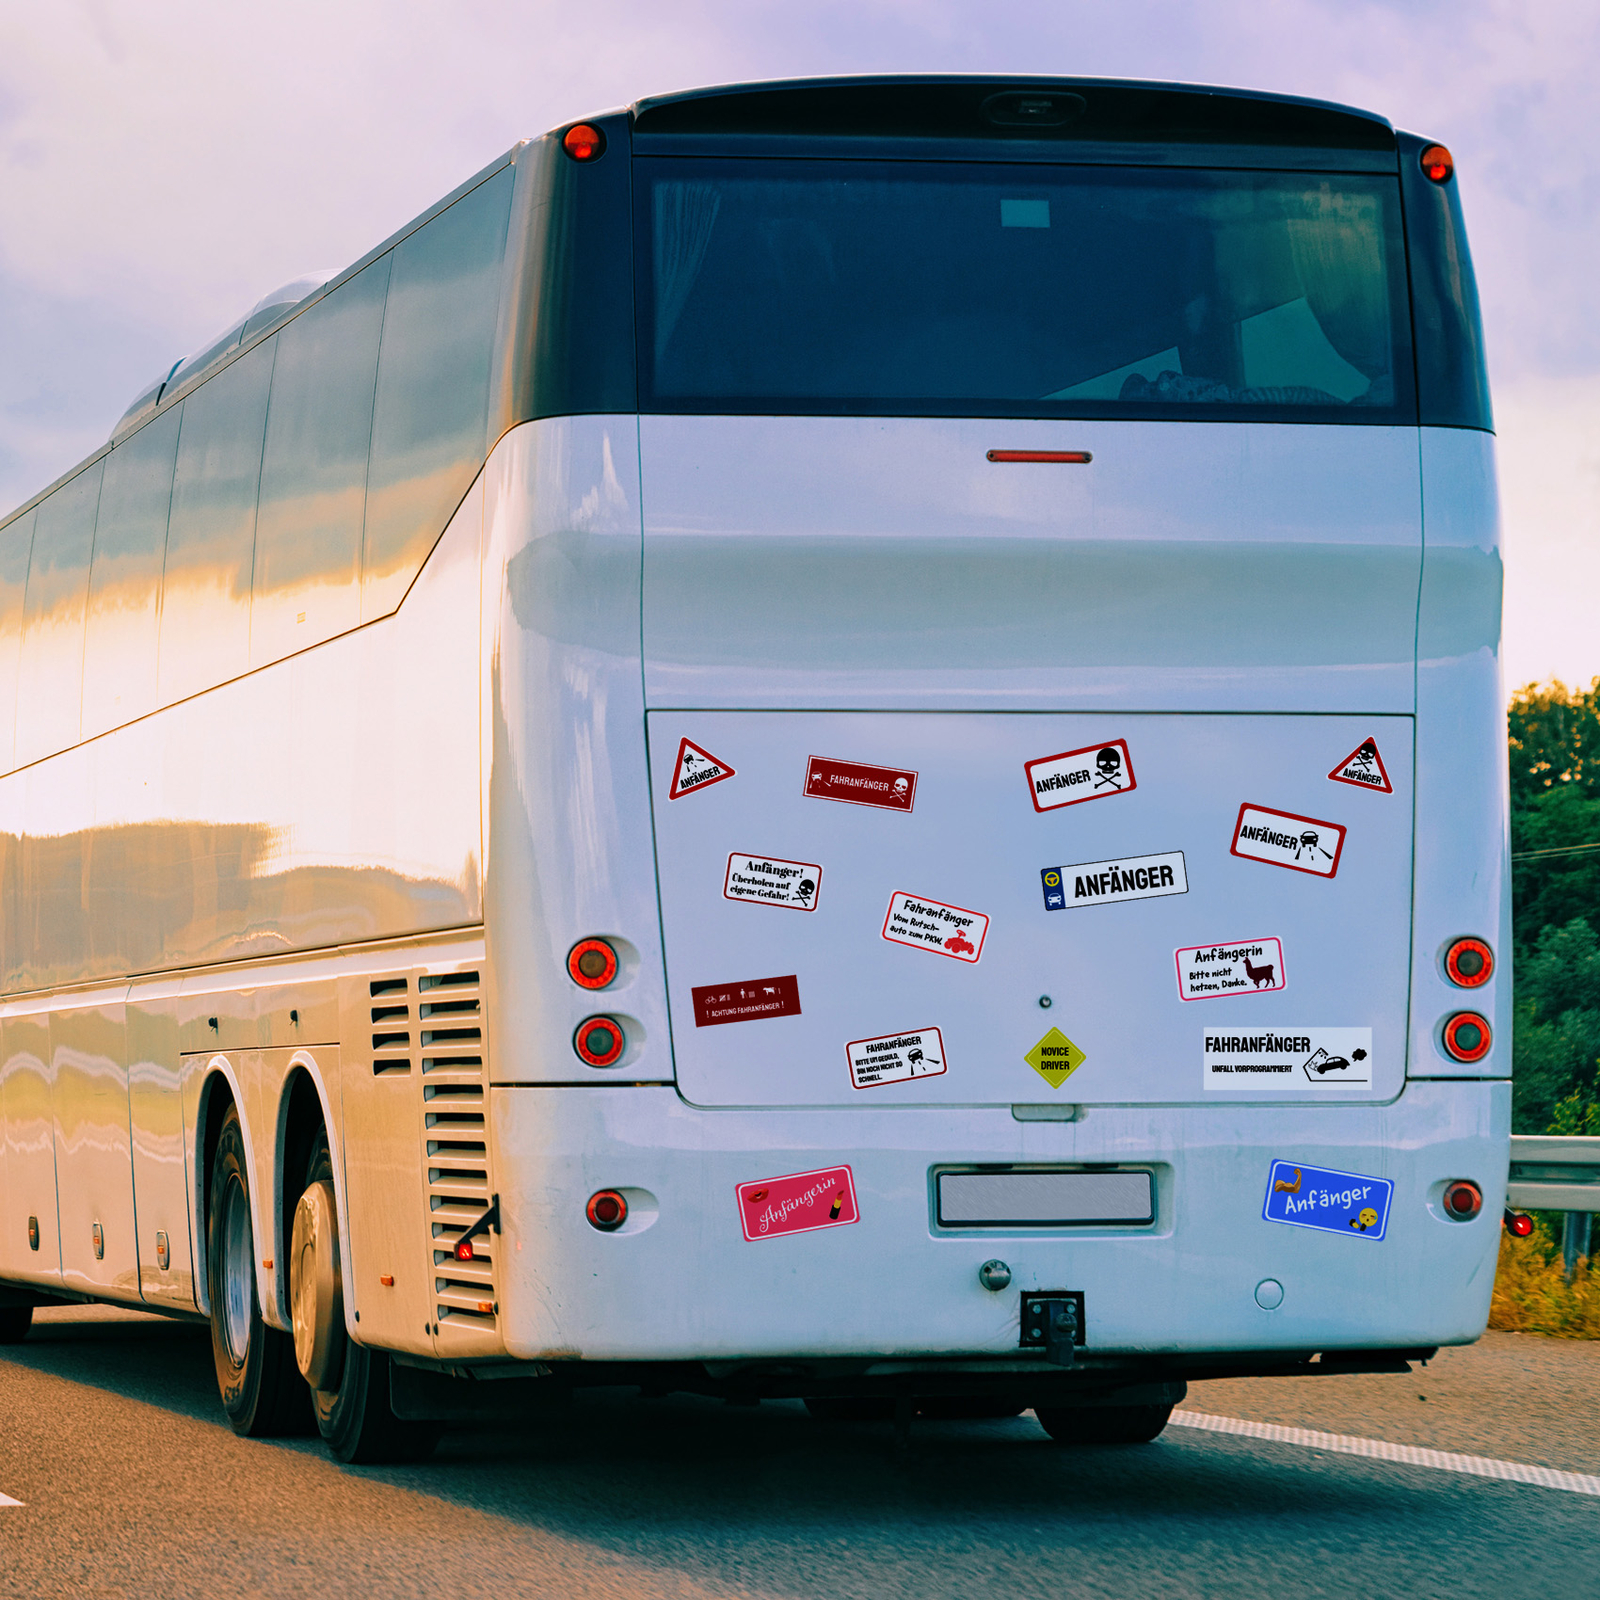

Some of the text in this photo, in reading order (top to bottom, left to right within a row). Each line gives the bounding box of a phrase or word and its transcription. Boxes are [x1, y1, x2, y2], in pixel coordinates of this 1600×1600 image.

[680, 766, 720, 789] ANFÄNGER
[830, 774, 889, 792] FAHRANFÄNGER
[1036, 769, 1091, 793] ANFÄNGER
[1342, 768, 1382, 785] ANFÄNGER
[1240, 825, 1298, 850] ANFÄNGER
[745, 861, 804, 879] Anfänger!
[732, 873, 791, 890] Überholen auf
[1075, 865, 1174, 898] ANFÄNGER
[730, 885, 790, 901] eigene Gefahr!
[893, 913, 940, 931] Vom Rutsch-
[903, 900, 974, 928] Fahranfänger
[889, 925, 943, 945] auto zum PKW.
[1195, 945, 1263, 963] Anfängerin
[1189, 967, 1232, 980] Bitte nicht
[1190, 978, 1247, 992] hetzen, Danke.
[711, 1007, 737, 1018] ACHTUNG
[737, 1002, 781, 1014] FAHRANFÄNGER
[866, 1036, 922, 1053] FAHRANFÄNGER
[1041, 1046, 1070, 1057] NOVICE
[1205, 1033, 1311, 1053] FAHRANFÄNGER
[1040, 1060, 1070, 1071] DRIVER
[1212, 1065, 1293, 1073] UNFALL VORPROGRAMMIERT
[759, 1177, 836, 1233] Anfängerin
[1285, 1186, 1372, 1215] Anfänger
